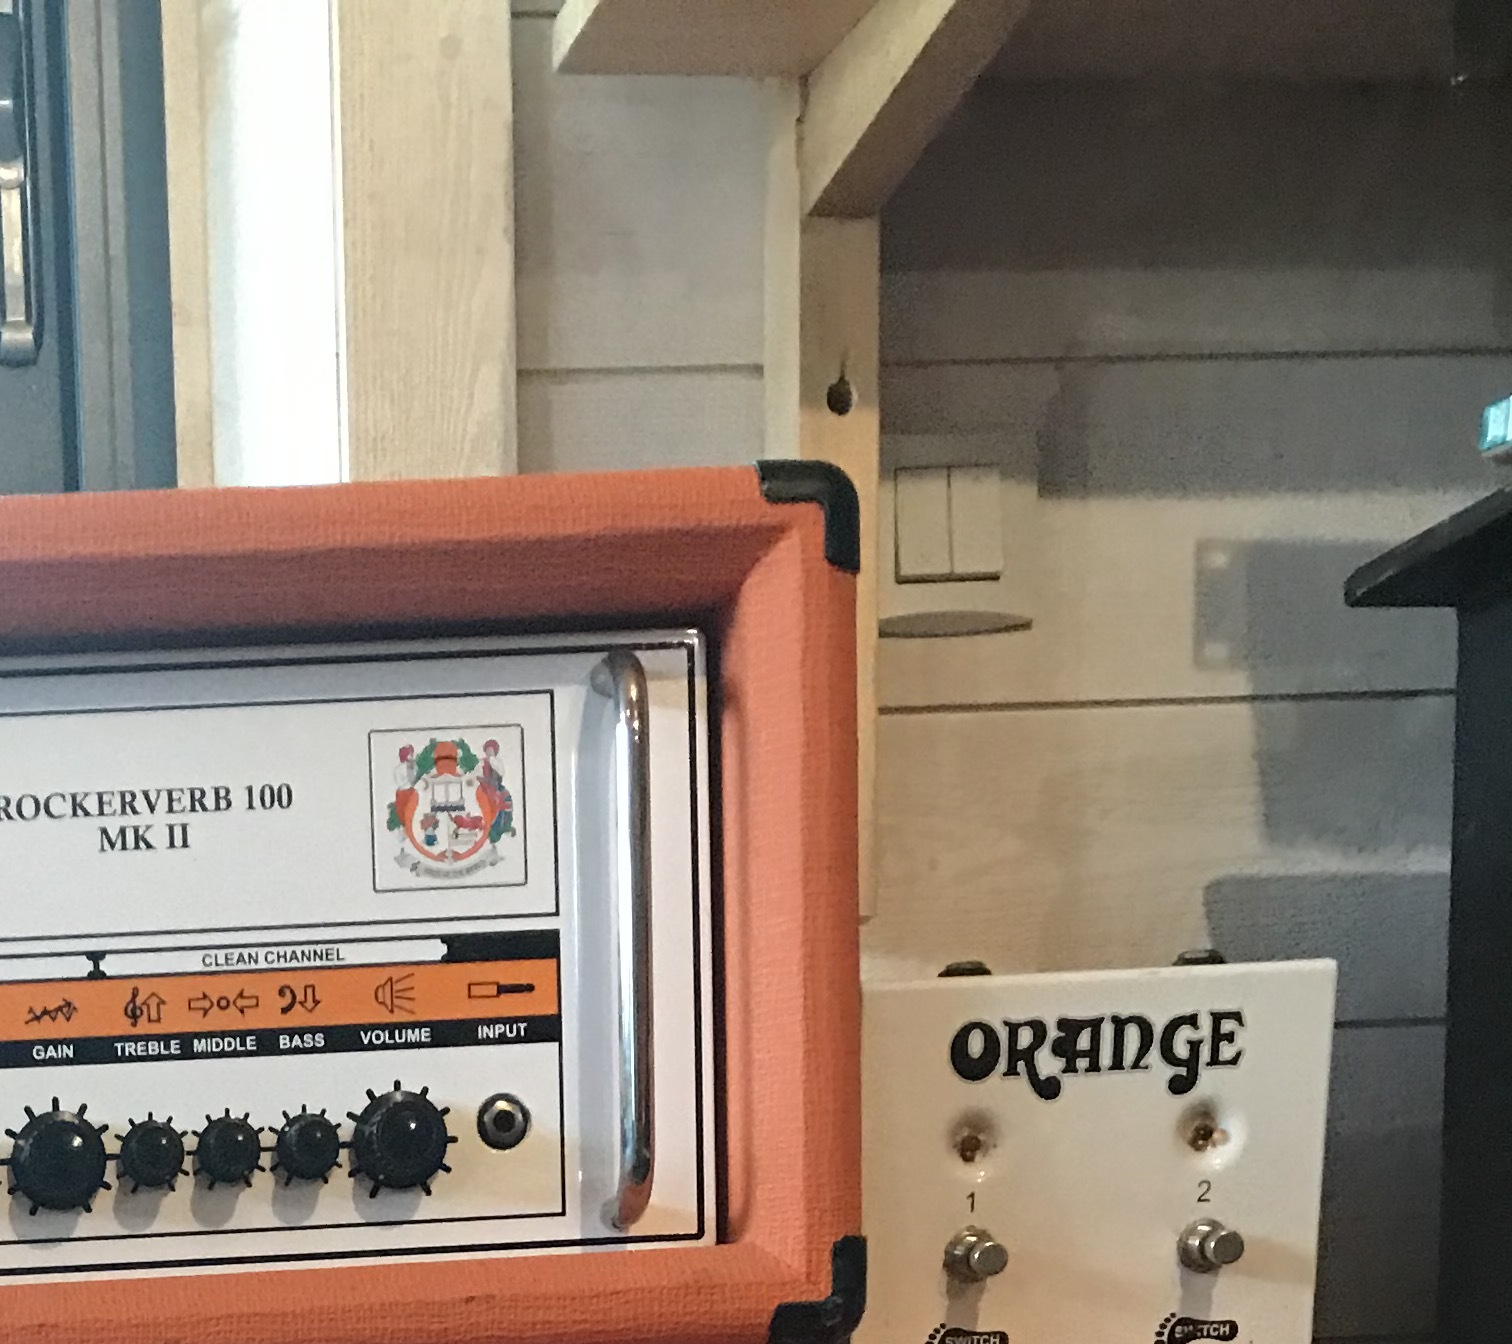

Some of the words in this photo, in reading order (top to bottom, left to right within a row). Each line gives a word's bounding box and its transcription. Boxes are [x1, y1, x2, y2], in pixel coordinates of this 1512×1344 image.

[245, 783, 293, 810] 100
[98, 824, 157, 853] MK
[165, 822, 191, 850] II
[202, 951, 259, 968] CLEAN
[264, 947, 345, 965] CHANNEL
[360, 1027, 432, 1045] VOLUME
[477, 1022, 528, 1039] INPUT
[114, 1040, 181, 1057] TREBLE
[193, 1036, 257, 1053] MIDDLE
[279, 1032, 325, 1049] BASS
[32, 1044, 74, 1060] GAIN
[949, 1009, 1245, 1101] ORANGE
[1196, 1179, 1212, 1203] 2
[965, 1190, 976, 1213] 1
